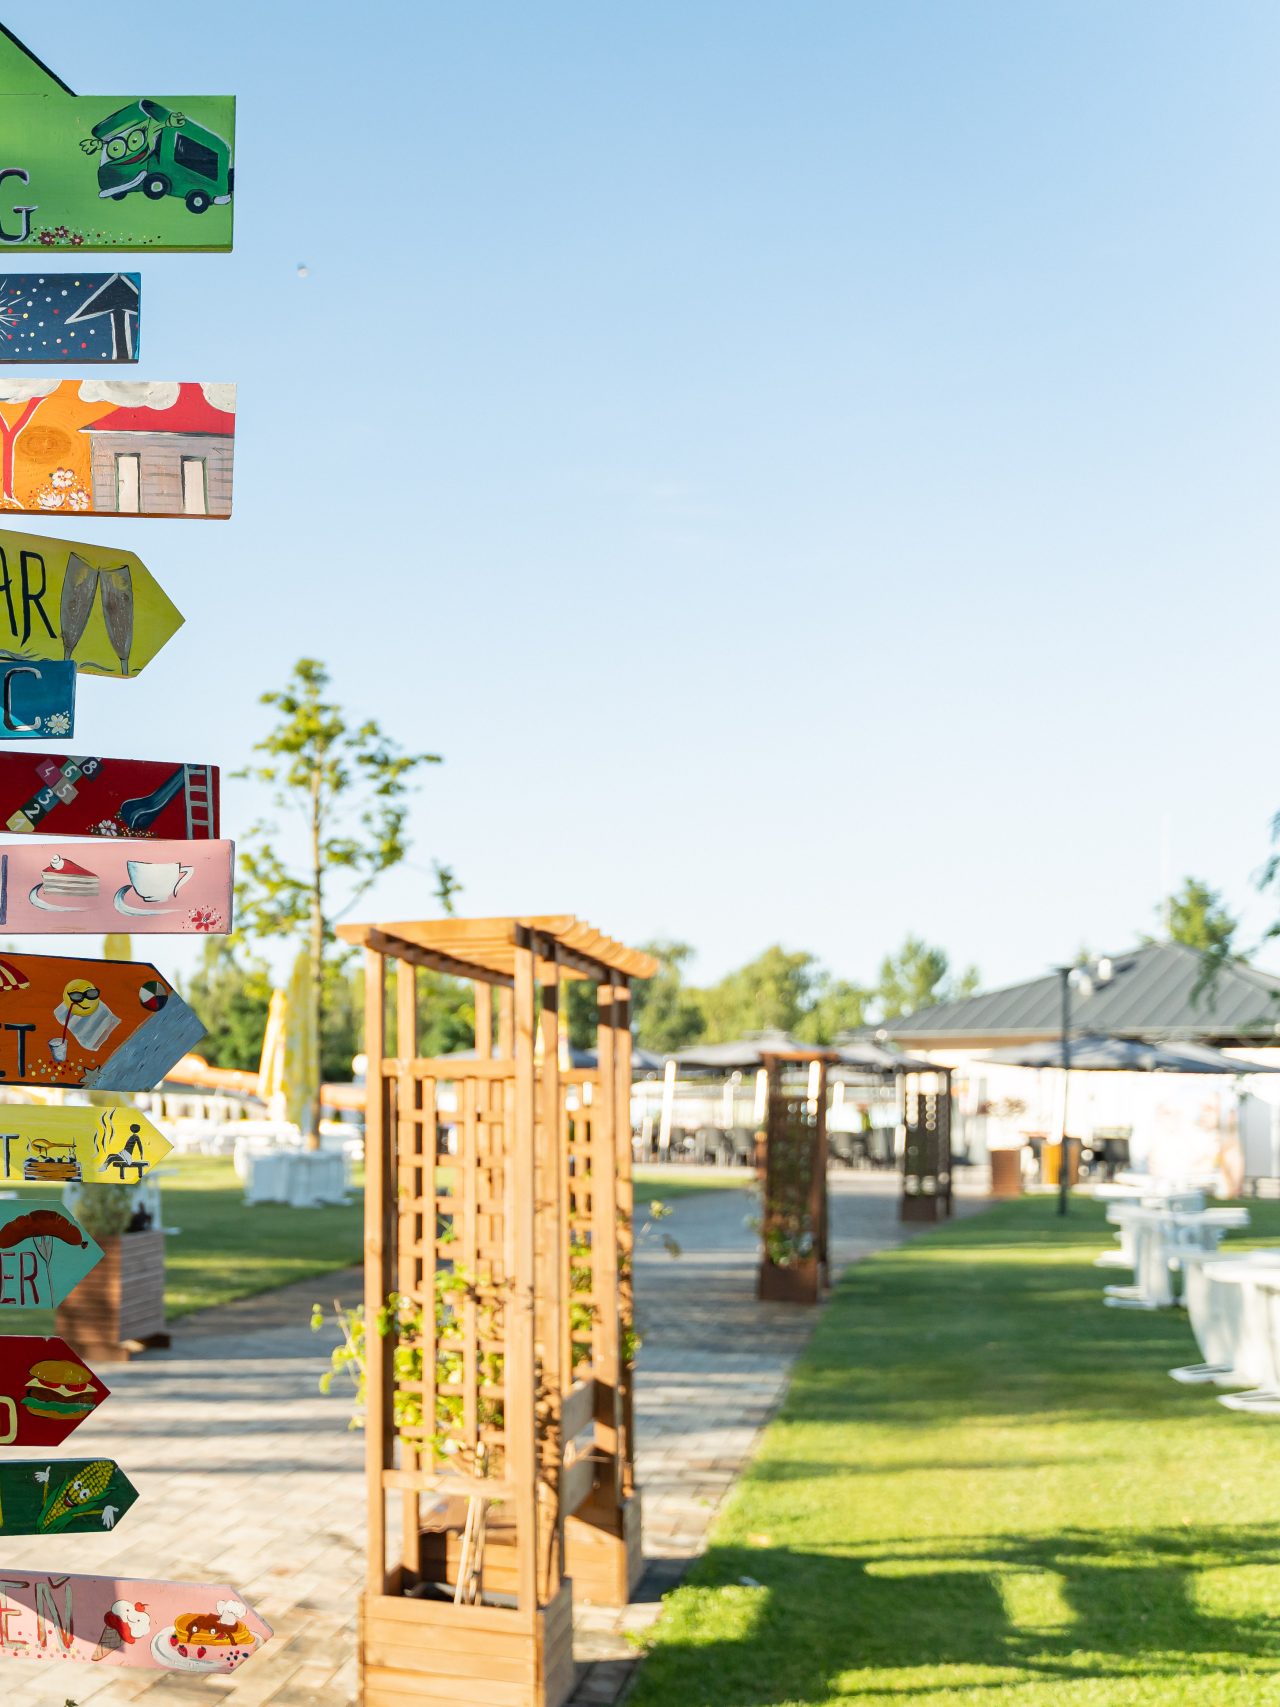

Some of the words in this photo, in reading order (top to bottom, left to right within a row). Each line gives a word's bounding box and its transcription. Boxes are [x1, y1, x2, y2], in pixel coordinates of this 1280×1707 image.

[64, 765, 78, 778] 6
[82, 760, 98, 775] 8
[38, 788, 54, 805] 3
[56, 783, 72, 798] 5
[24, 803, 41, 820] 2
